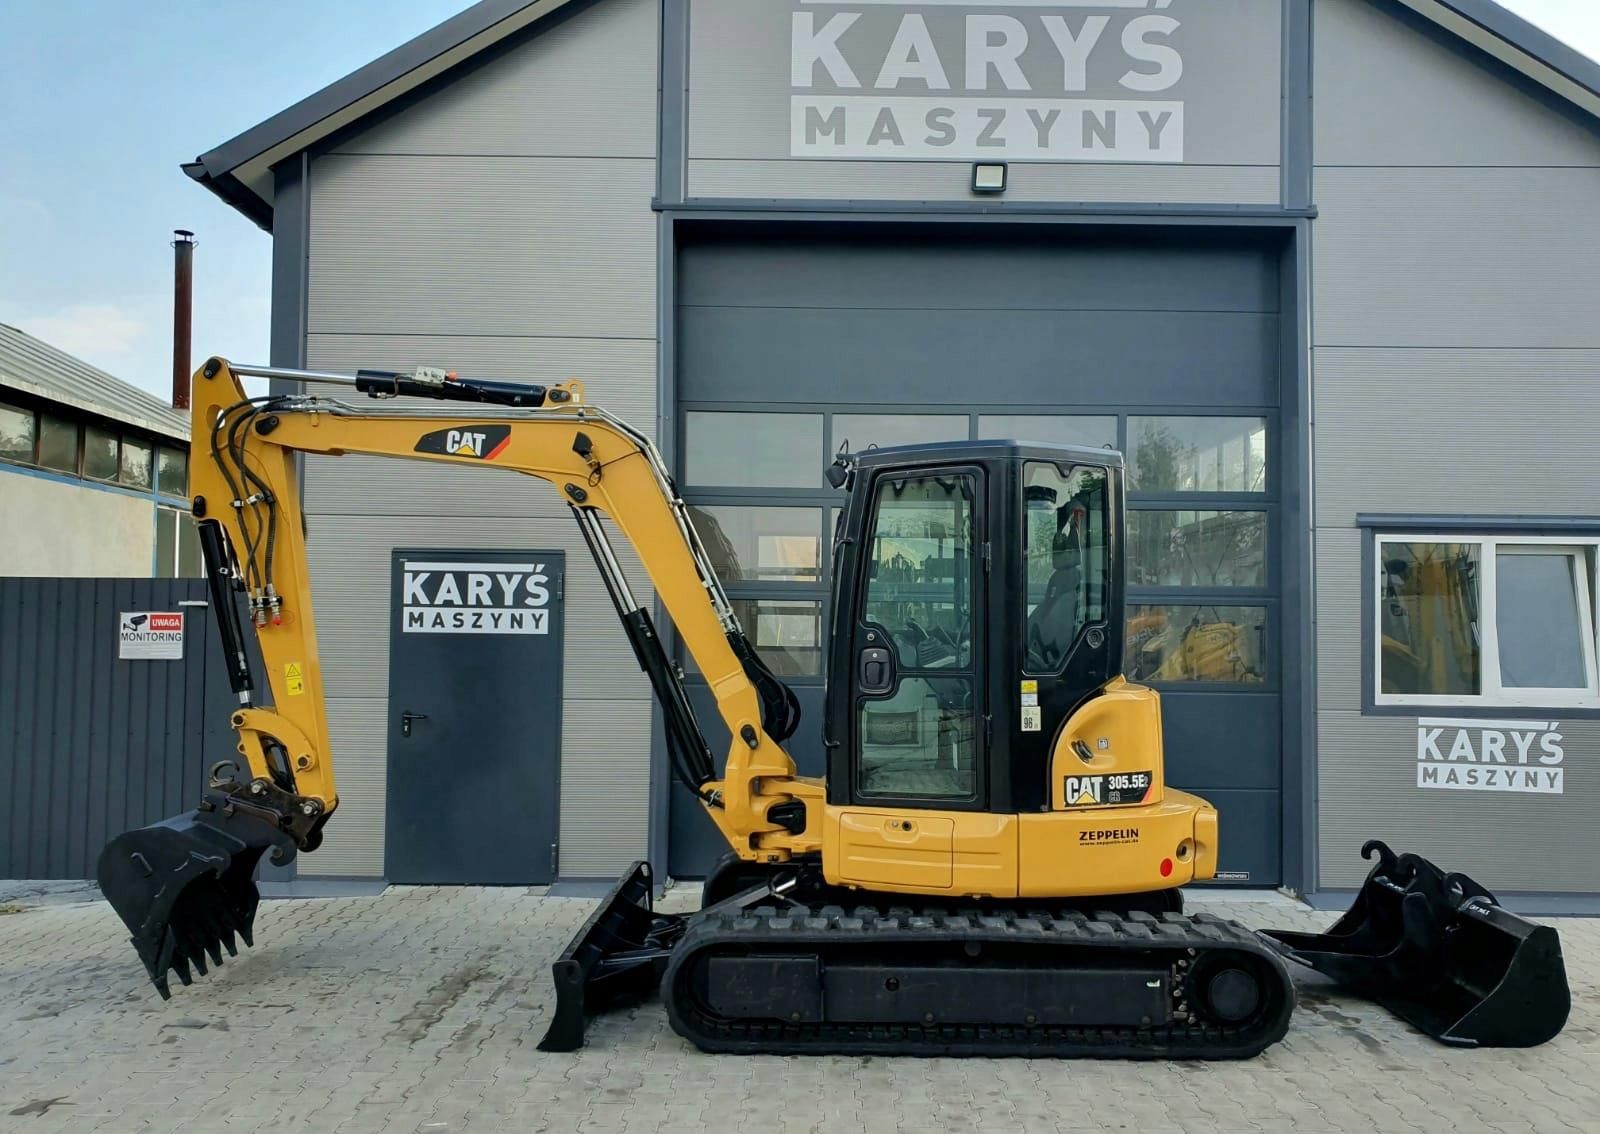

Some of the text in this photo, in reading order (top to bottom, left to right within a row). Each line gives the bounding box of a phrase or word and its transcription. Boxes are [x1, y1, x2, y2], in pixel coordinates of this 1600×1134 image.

[803, 106, 1173, 151] MASZYNY
[446, 430, 486, 457] CAT
[403, 563, 549, 606] KARYŚ
[152, 618, 180, 627] UWAGA
[408, 611, 544, 629] MASZYNY
[121, 632, 182, 642] MONITORING
[1417, 722, 1564, 765] KARYŚ
[1066, 776, 1103, 804] CAT
[1422, 767, 1559, 789] MASZYNY
[1079, 828, 1139, 841] ZEPPELIN
